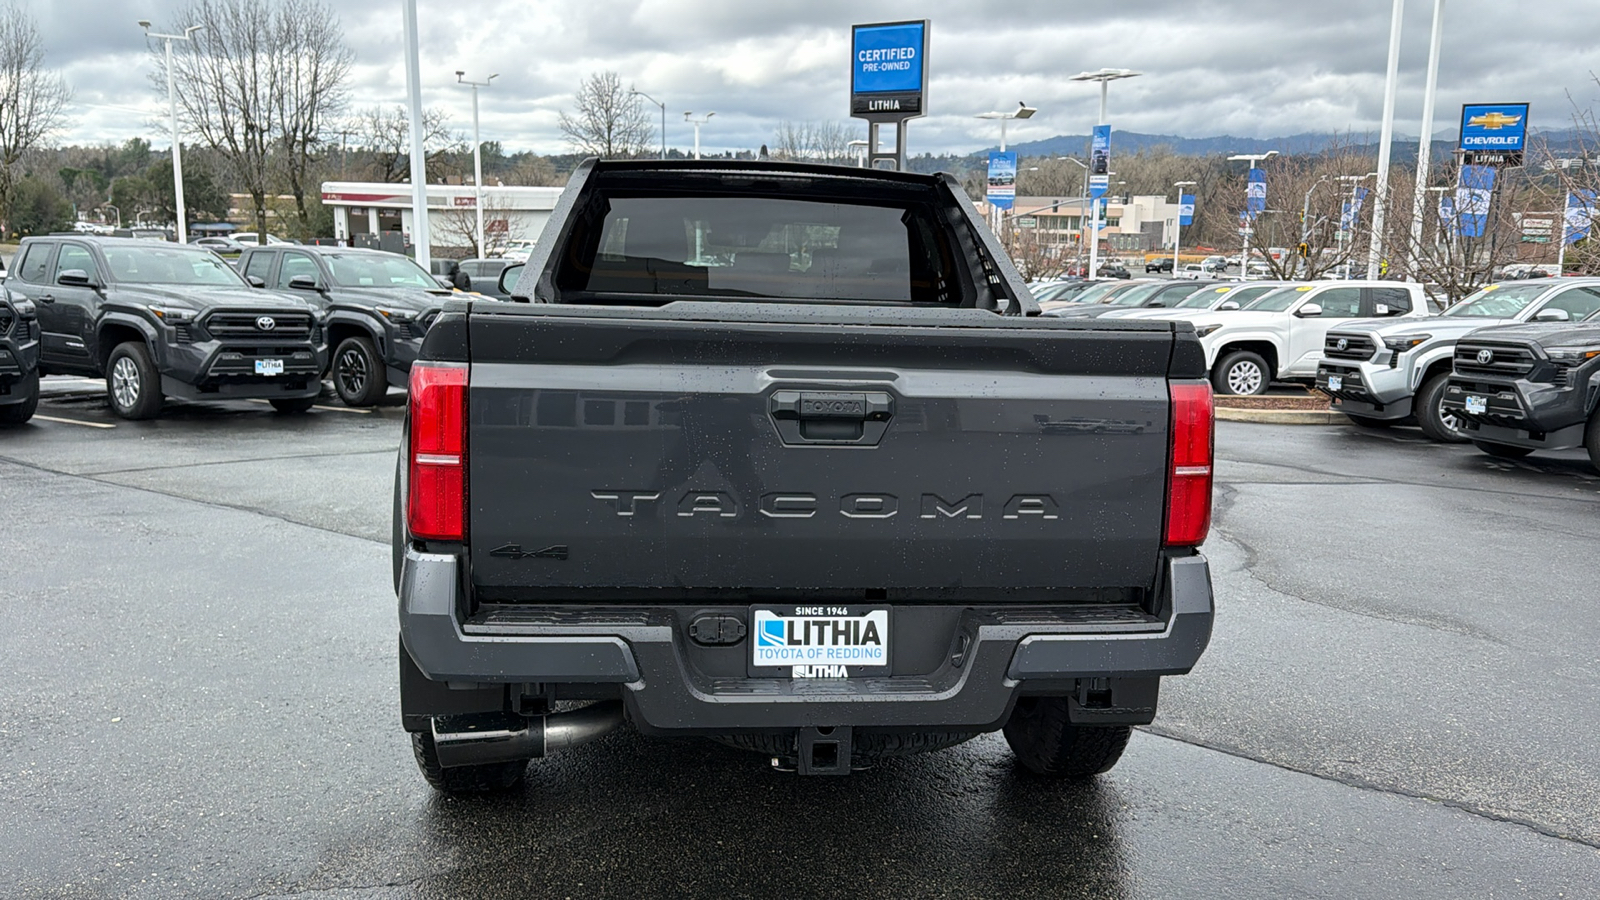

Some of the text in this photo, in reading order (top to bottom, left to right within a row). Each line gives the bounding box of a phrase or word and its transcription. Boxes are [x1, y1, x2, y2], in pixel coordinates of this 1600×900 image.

[858, 47, 915, 62] CERTIFIED
[862, 61, 911, 72] PRE-OWNED
[868, 99, 900, 111] LITHIA
[1464, 136, 1520, 145] CHEVROLET
[803, 400, 862, 413] TOYOTA
[591, 490, 1060, 519] TACOMA
[795, 607, 848, 615] SINCE 1946
[787, 620, 882, 646] LITHIA
[758, 648, 882, 659] TOYOTA OF REDDING
[805, 665, 849, 678] LITHIA
